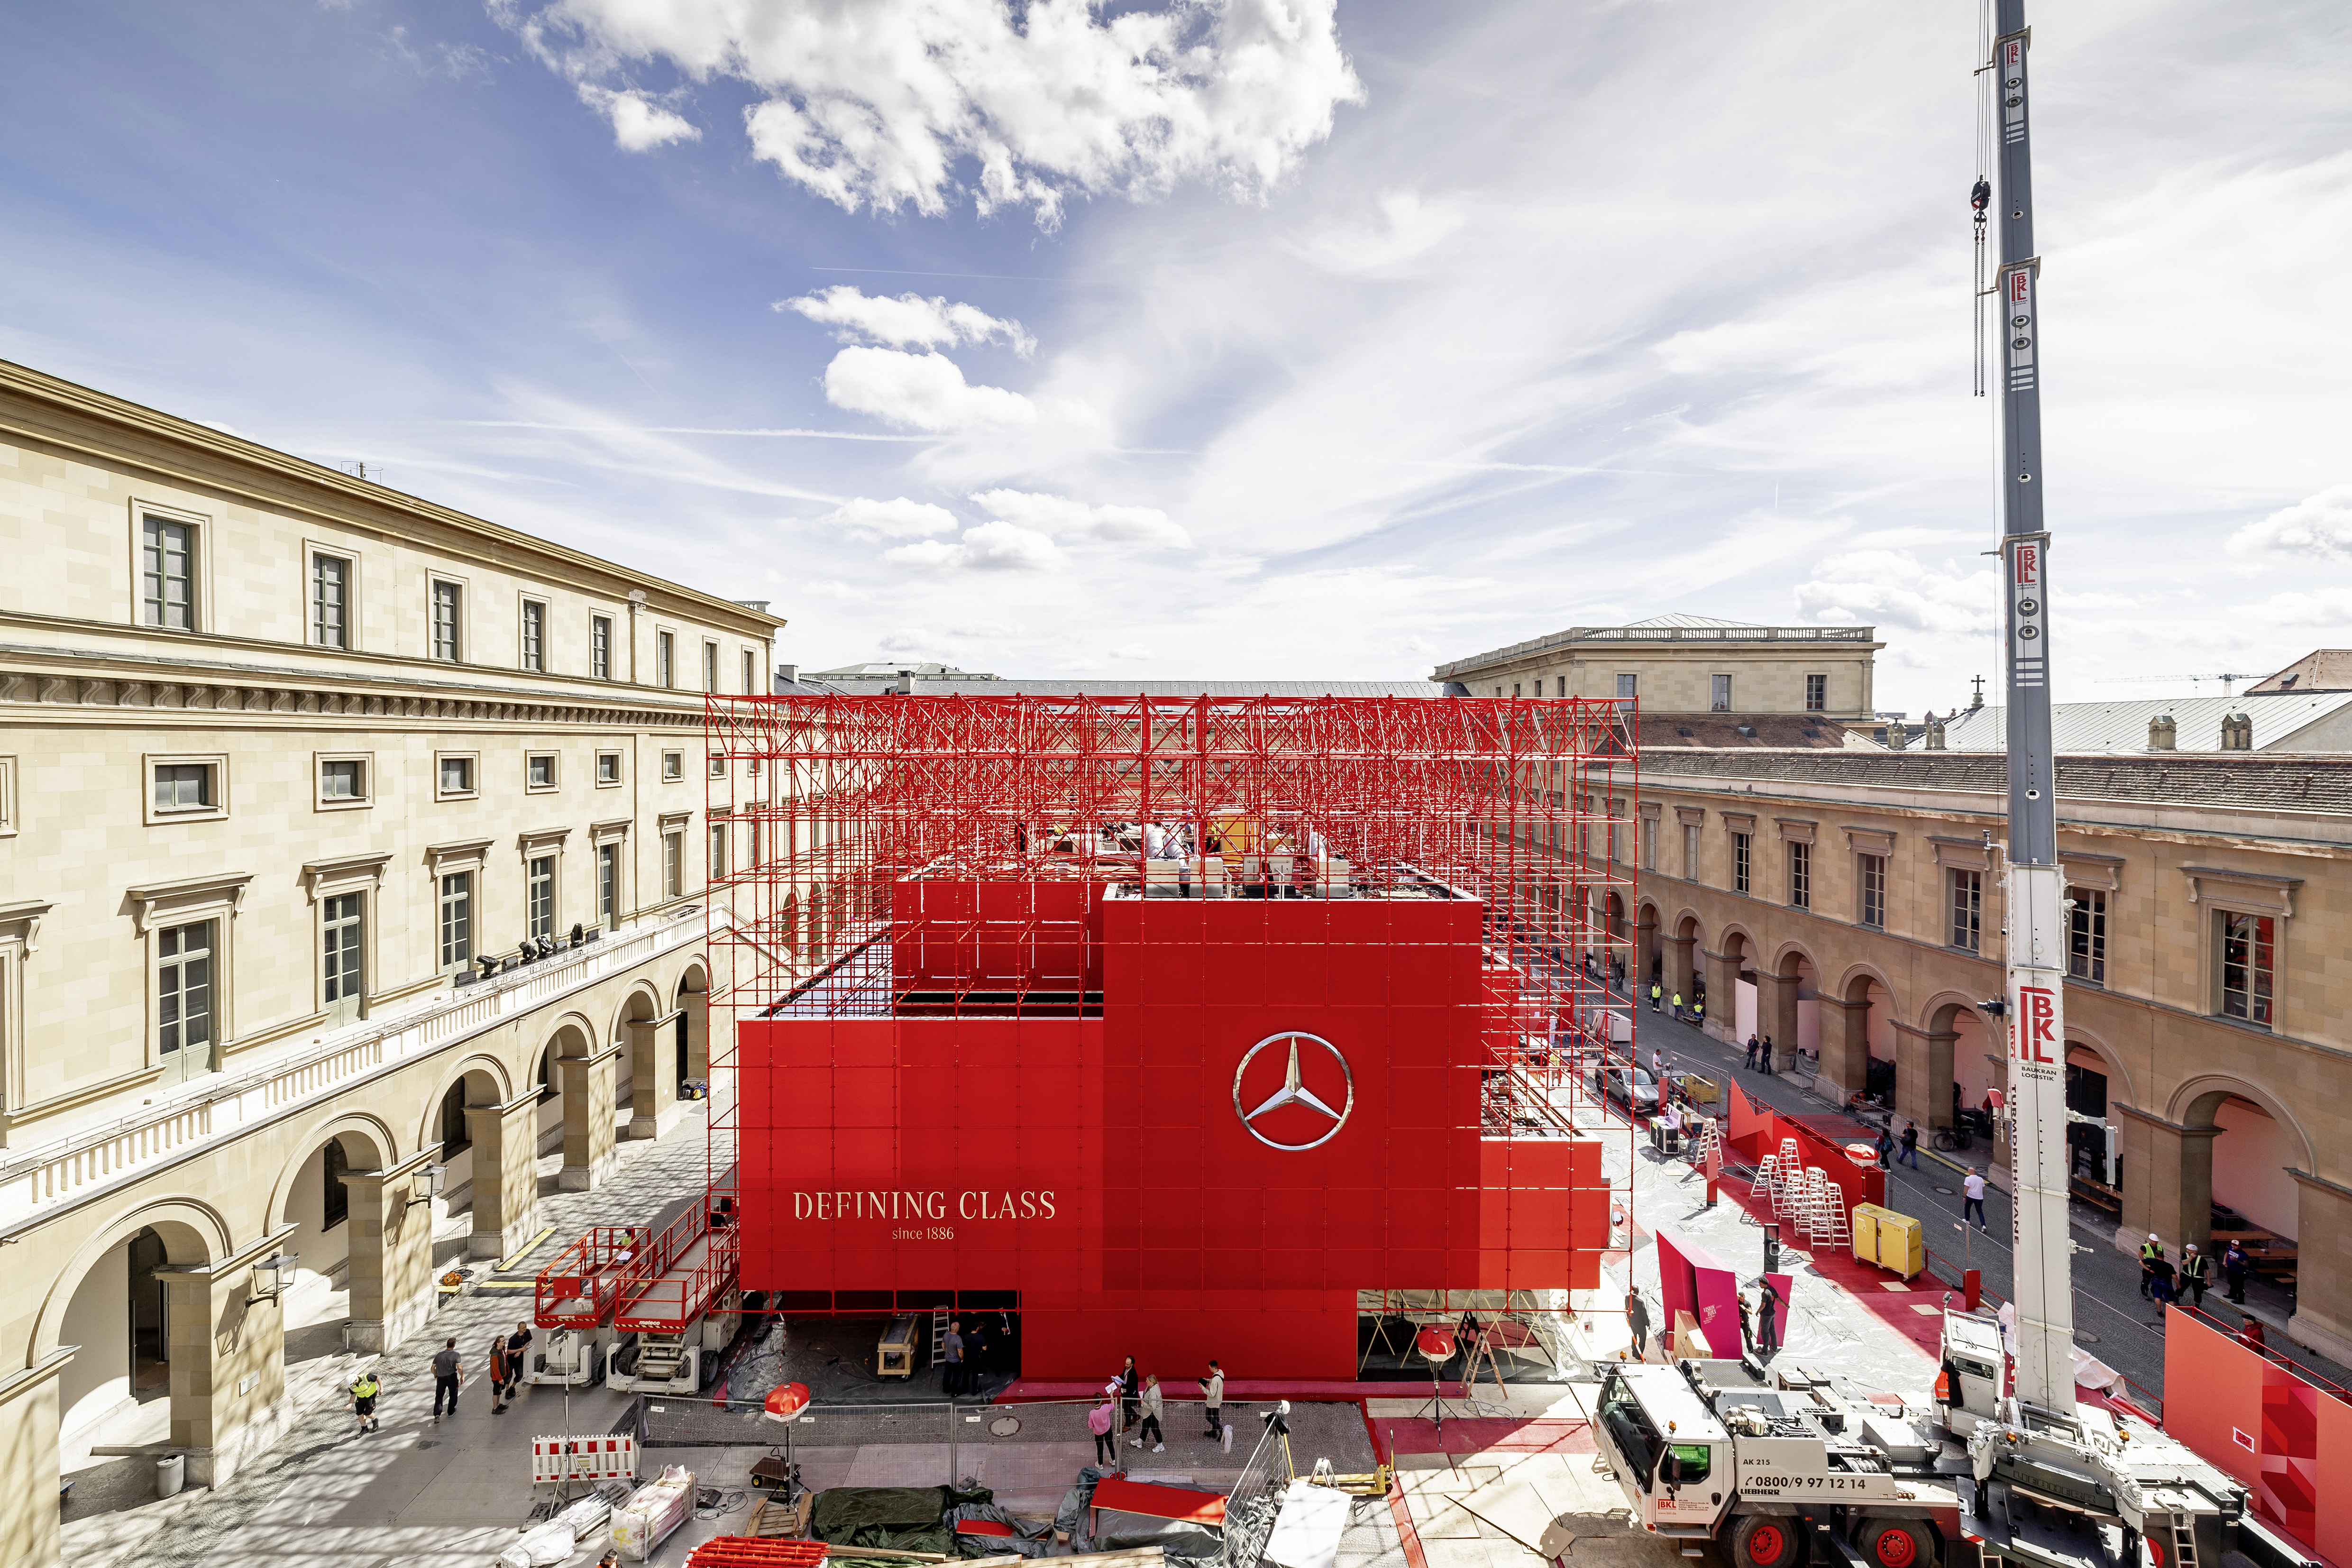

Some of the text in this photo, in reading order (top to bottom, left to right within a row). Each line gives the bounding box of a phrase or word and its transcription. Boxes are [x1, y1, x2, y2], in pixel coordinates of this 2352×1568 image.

[2017, 275, 2027, 301] BKL
[2023, 550, 2037, 583] BKL
[2032, 995, 2056, 1064] BKL
[2022, 1066, 2057, 1076] BAUKRAN
[2022, 1073, 2054, 1082] LOGISTIK
[2011, 1084, 2019, 1245] TURMDREHKRANE
[793, 1191, 1055, 1220] DEFINING CLASS
[892, 1227, 954, 1239] since 1886
[1703, 1304, 1715, 1313] VISION
[1756, 1476, 1866, 1489] 0800/9 97 12 14
[2013, 1470, 2096, 1504] LIEBHERR
